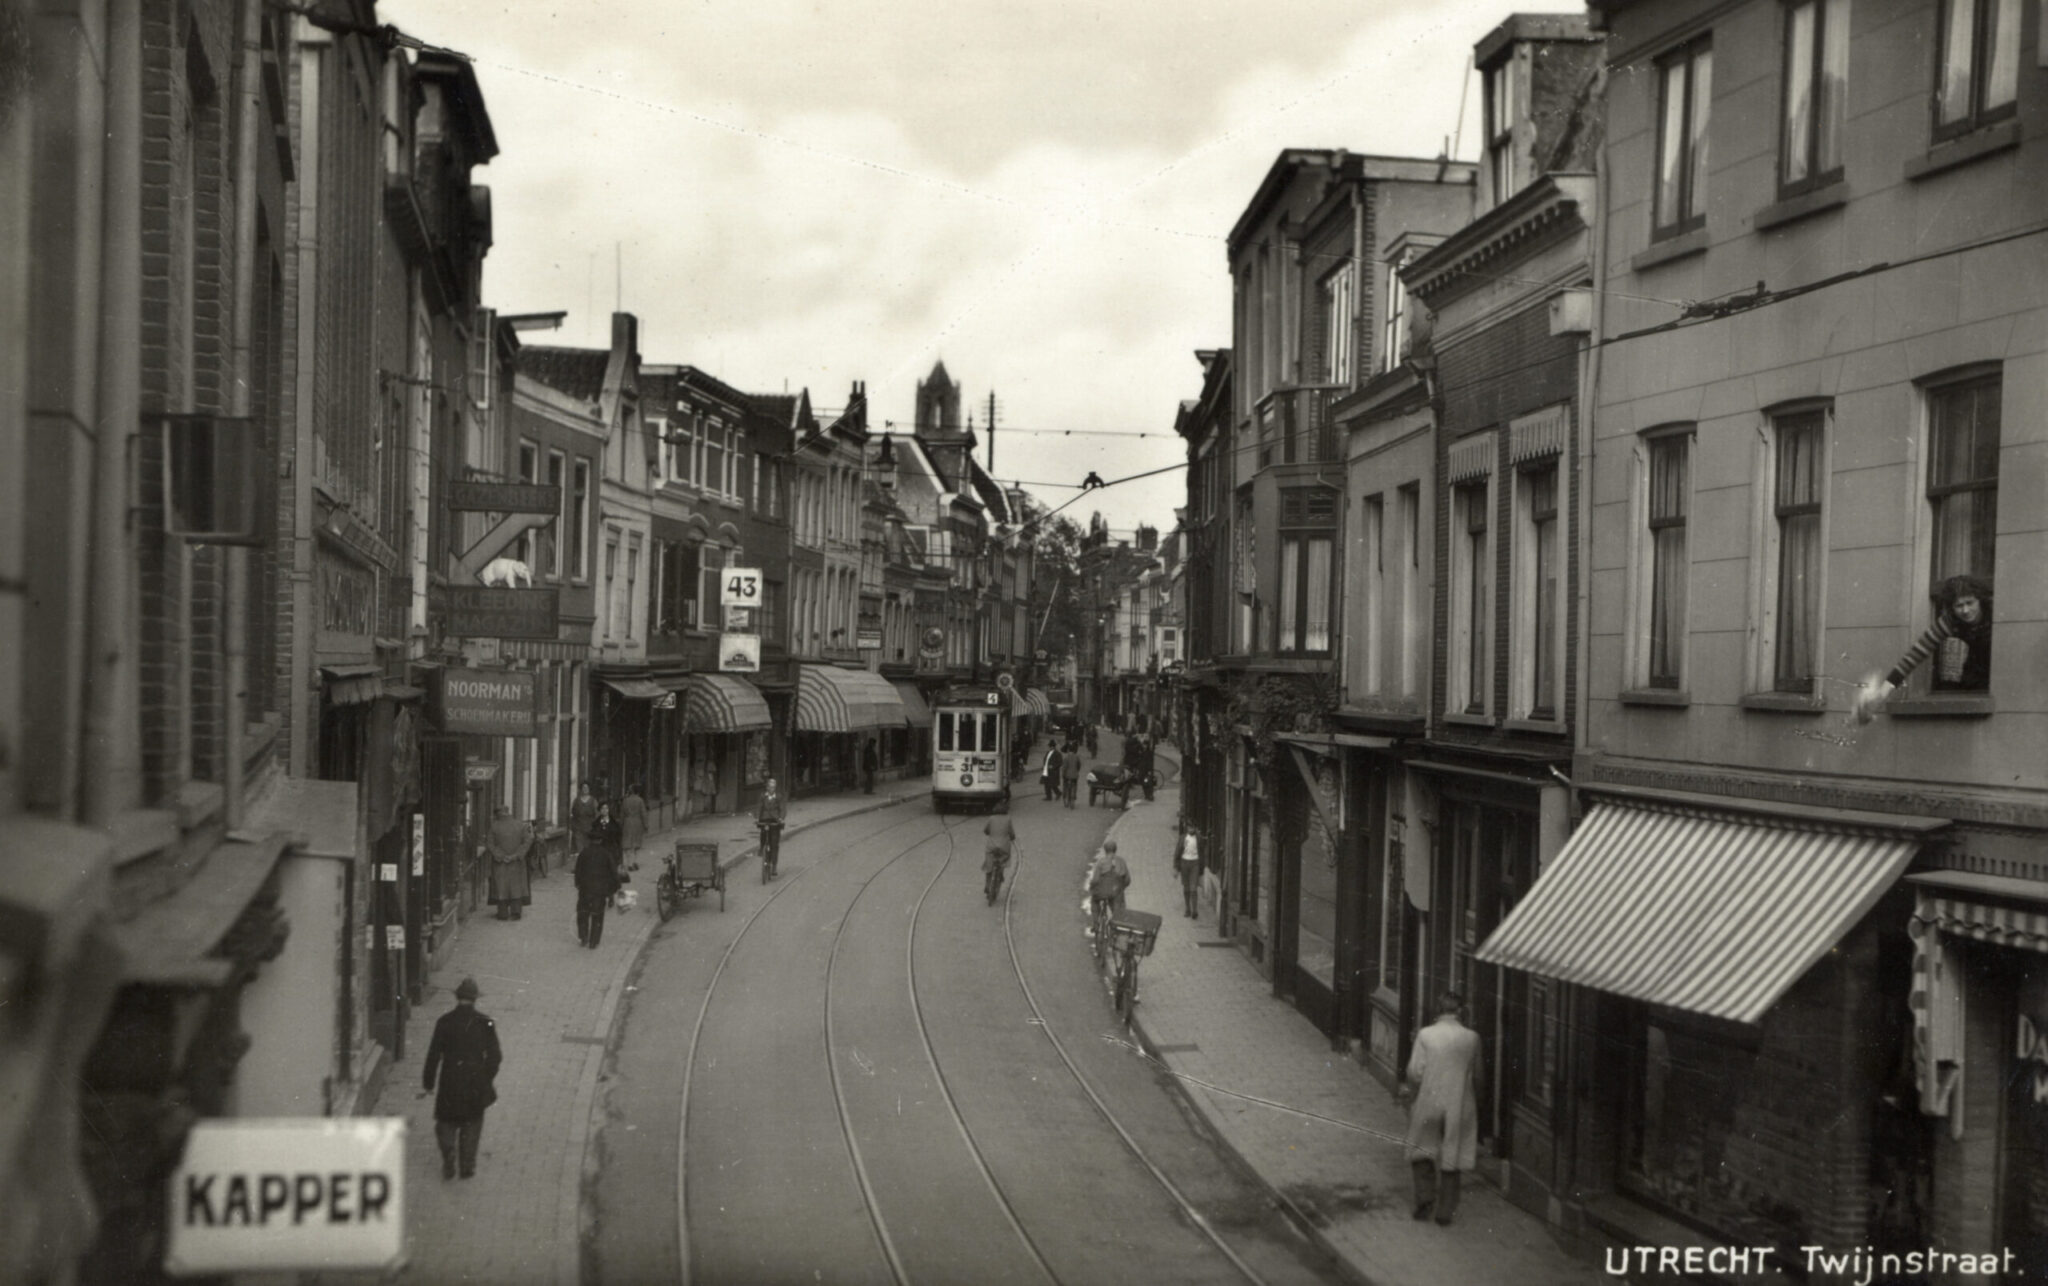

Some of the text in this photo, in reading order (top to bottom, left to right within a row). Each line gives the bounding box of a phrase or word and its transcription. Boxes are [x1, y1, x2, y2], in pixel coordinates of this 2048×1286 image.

[727, 576, 757, 598] 43
[453, 591, 552, 612] KLEEDING
[960, 762, 974, 773] 31
[187, 1173, 390, 1225] KAPPER
